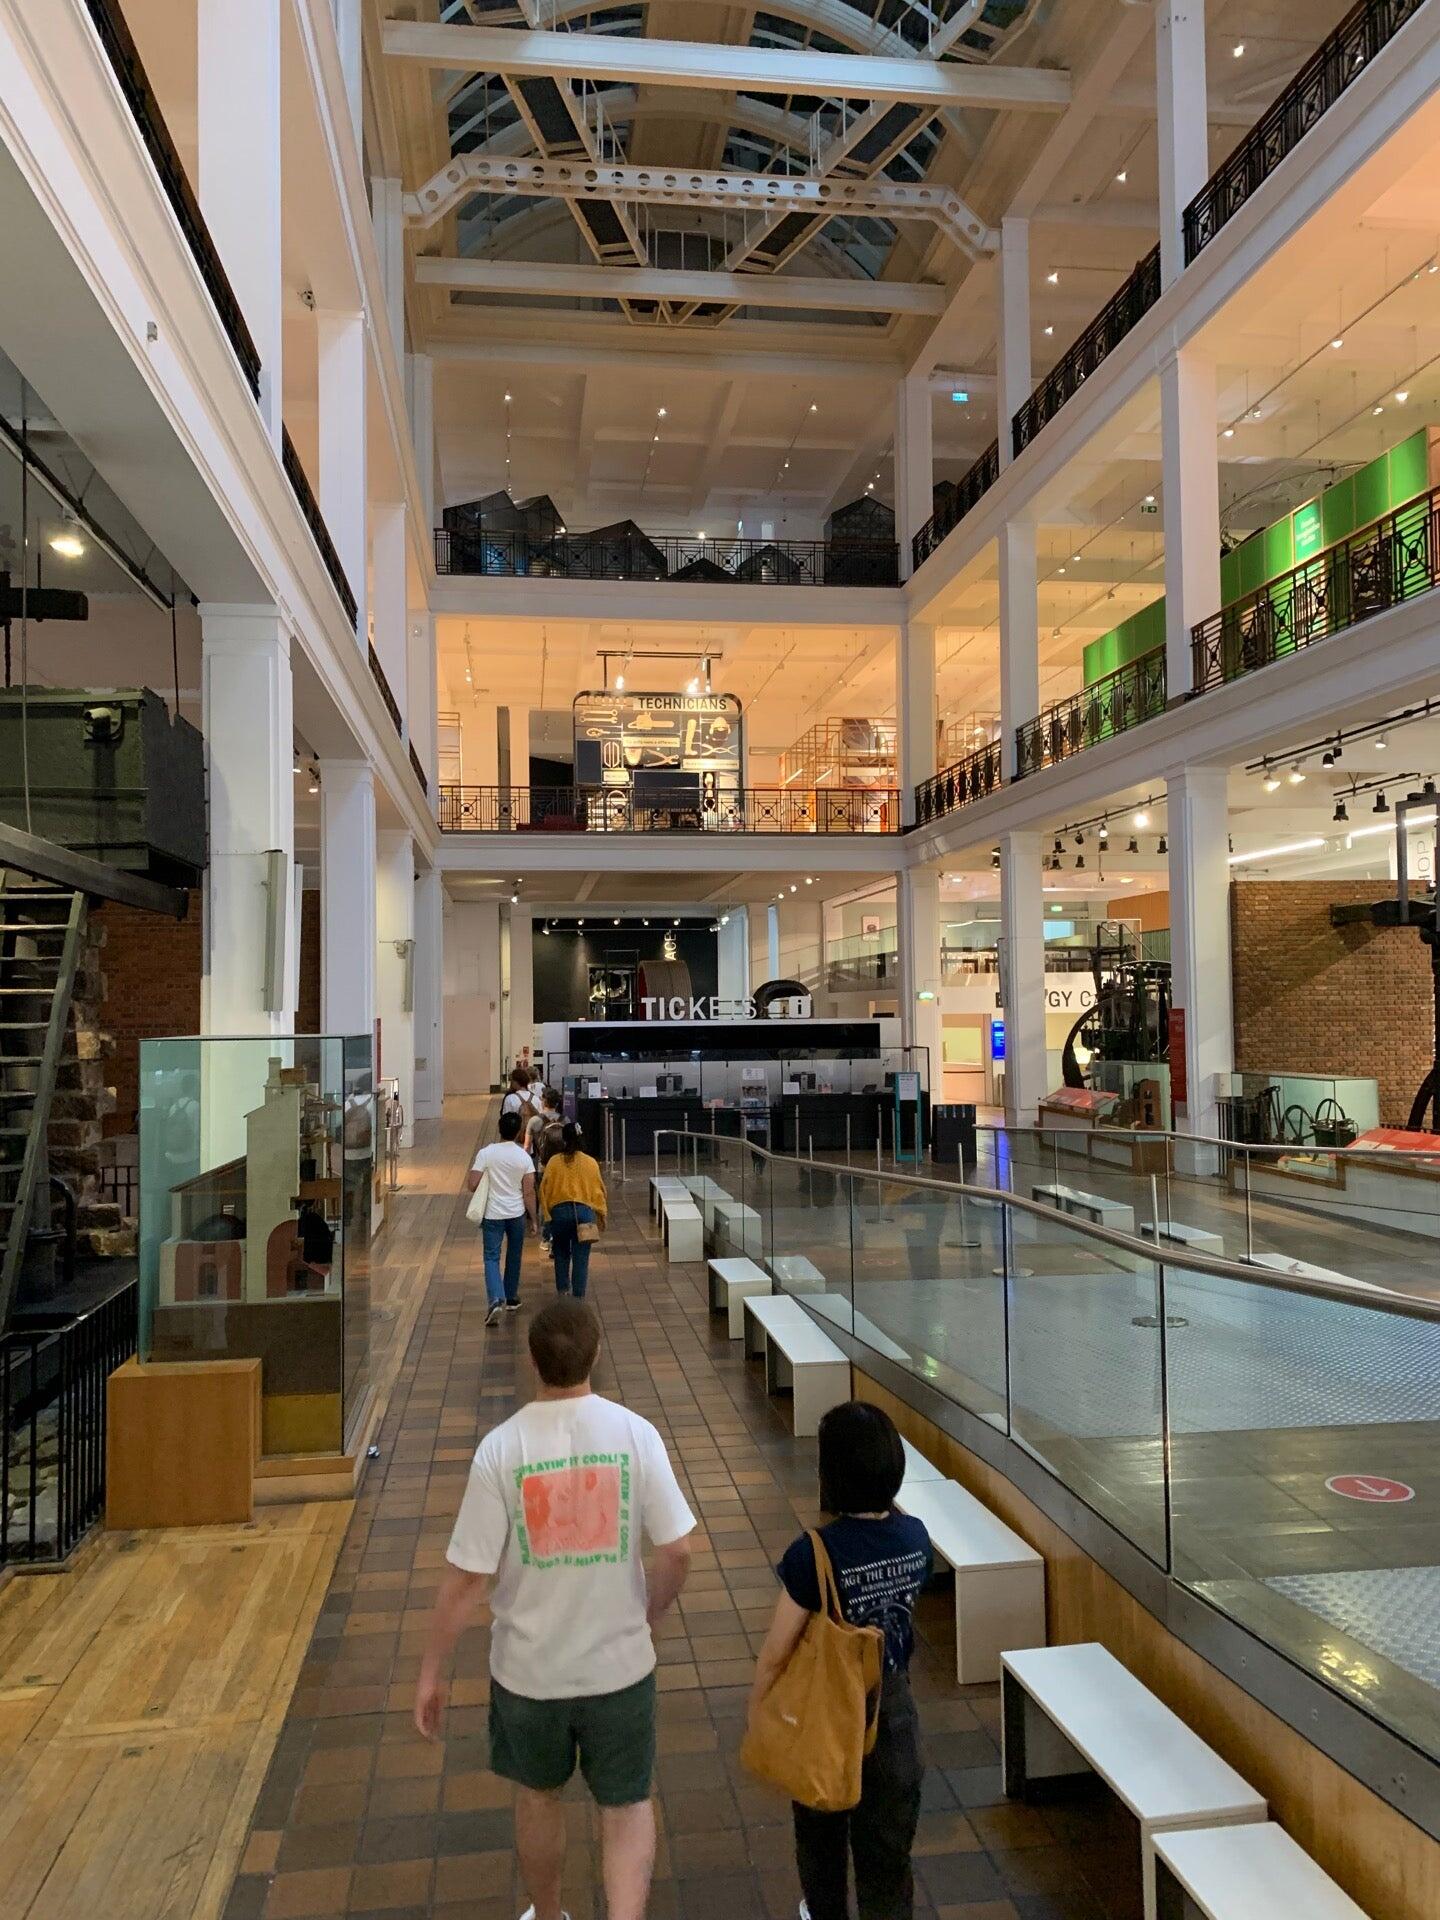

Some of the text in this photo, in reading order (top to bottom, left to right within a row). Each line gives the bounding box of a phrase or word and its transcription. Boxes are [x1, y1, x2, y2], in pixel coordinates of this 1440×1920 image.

[638, 697, 727, 710] TECHNICIANS
[641, 996, 757, 1021] TICKES
[865, 1568, 884, 1583] THE
